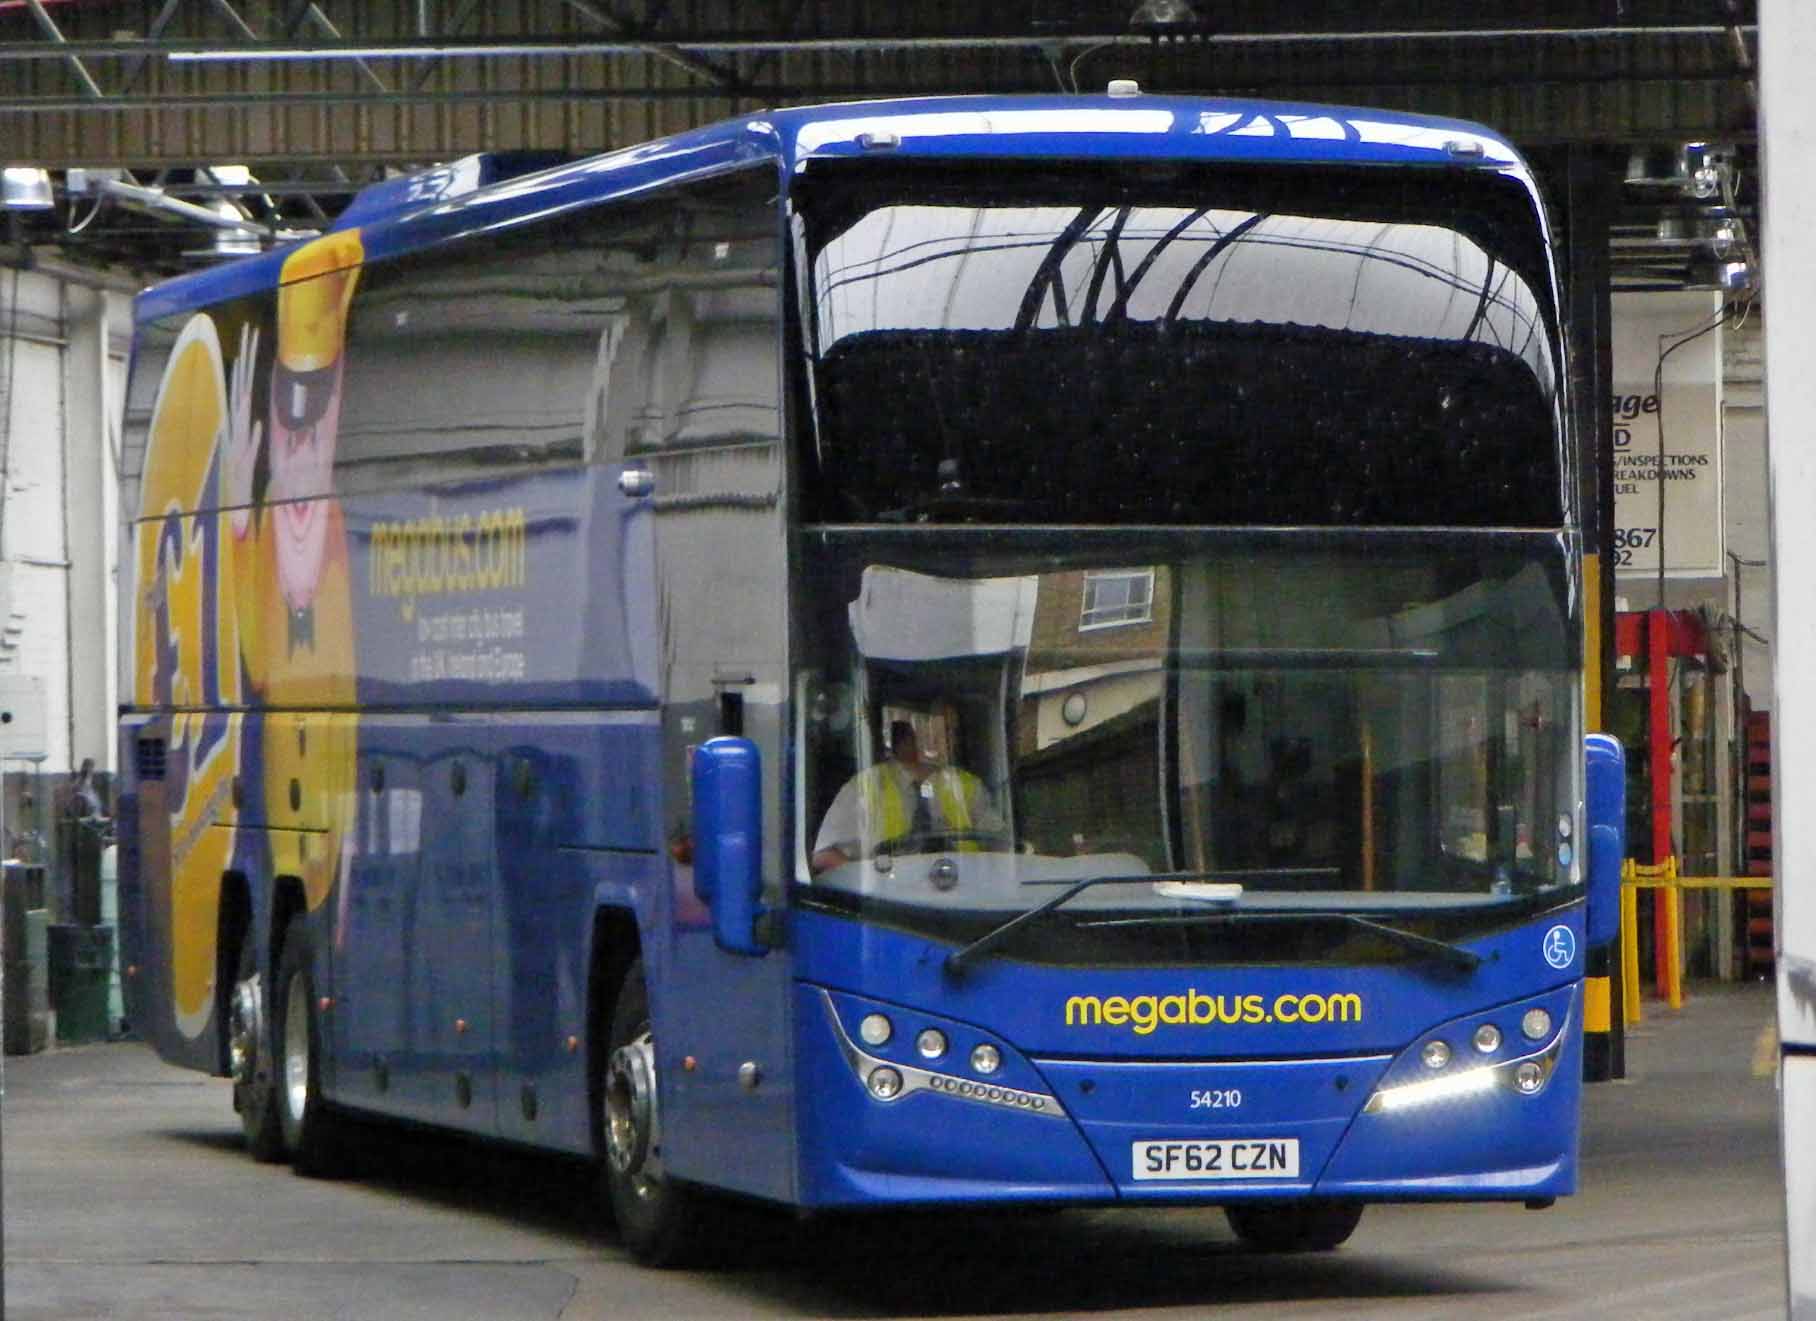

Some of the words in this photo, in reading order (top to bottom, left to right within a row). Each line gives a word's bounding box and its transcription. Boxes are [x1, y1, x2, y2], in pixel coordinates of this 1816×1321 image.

[1613, 454, 1709, 468] /INSPECTIONS
[1613, 483, 1640, 495] UEL
[1614, 528, 1657, 549] 867
[1065, 988, 1362, 1035] megabus.com
[1189, 1089, 1242, 1109] 54210
[1145, 1144, 1222, 1173] SF62
[1230, 1142, 1287, 1171] CZN
